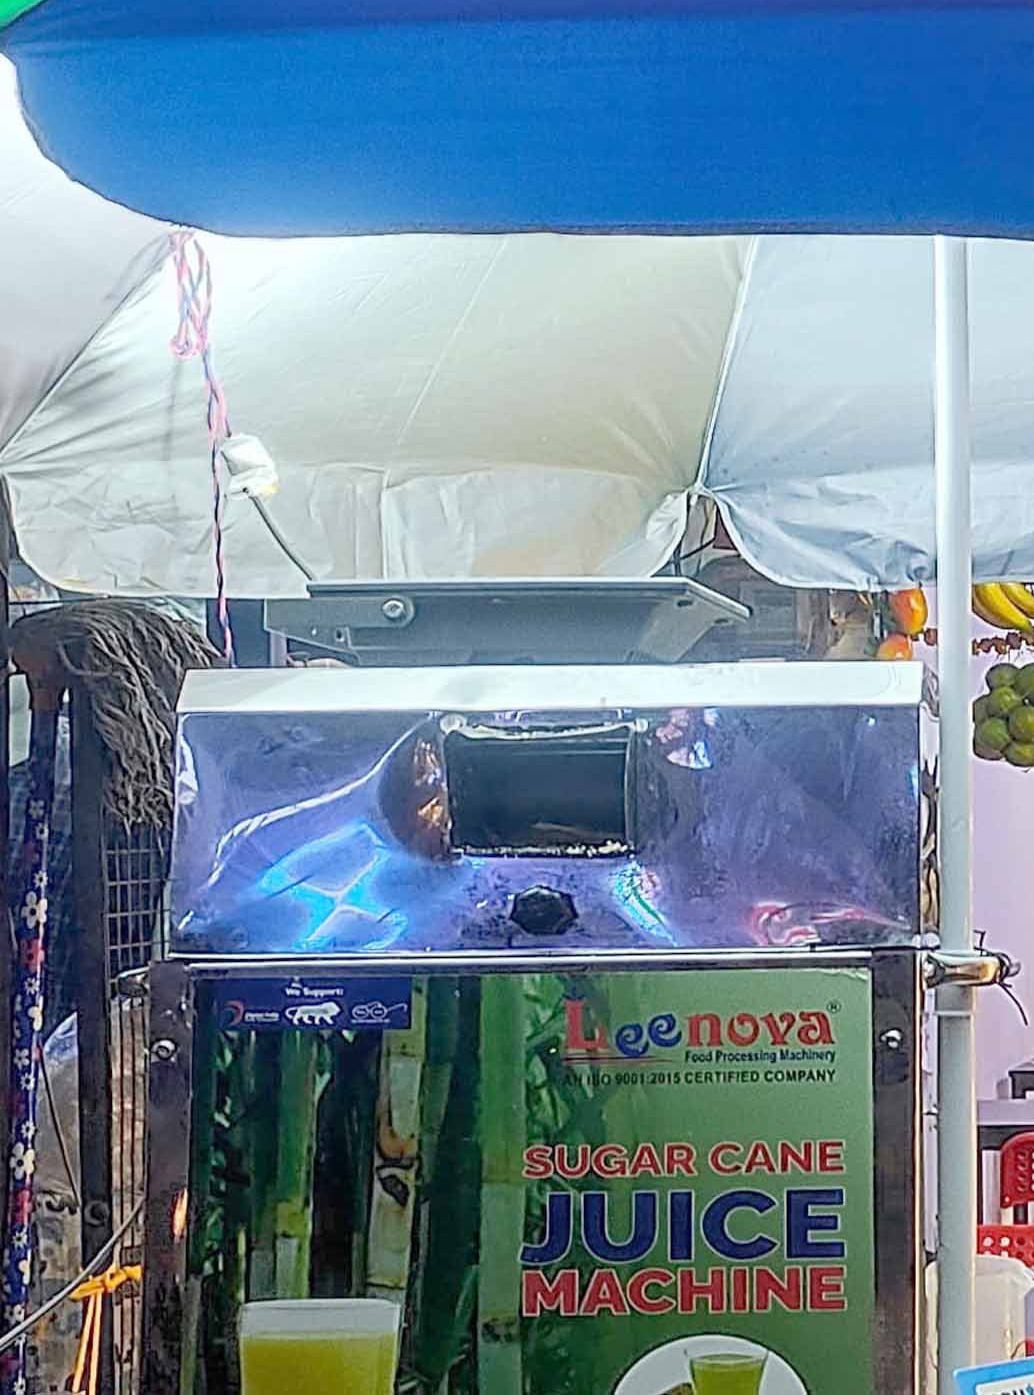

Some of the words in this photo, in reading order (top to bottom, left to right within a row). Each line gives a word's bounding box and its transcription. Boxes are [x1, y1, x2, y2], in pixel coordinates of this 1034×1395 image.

[563, 999, 835, 1058] Leenova
[615, 1071, 680, 1085] 9001:2015
[685, 1070, 759, 1084] CERTIFIED
[766, 1069, 836, 1083] COMPANY
[685, 1050, 712, 1062] Food
[716, 1050, 777, 1064] Processing
[780, 1048, 836, 1062] Machinery
[522, 1142, 697, 1178] SUGAR
[709, 1140, 845, 1174] CANE
[520, 1187, 845, 1263] JUICE
[522, 1265, 846, 1317] MACHINE
